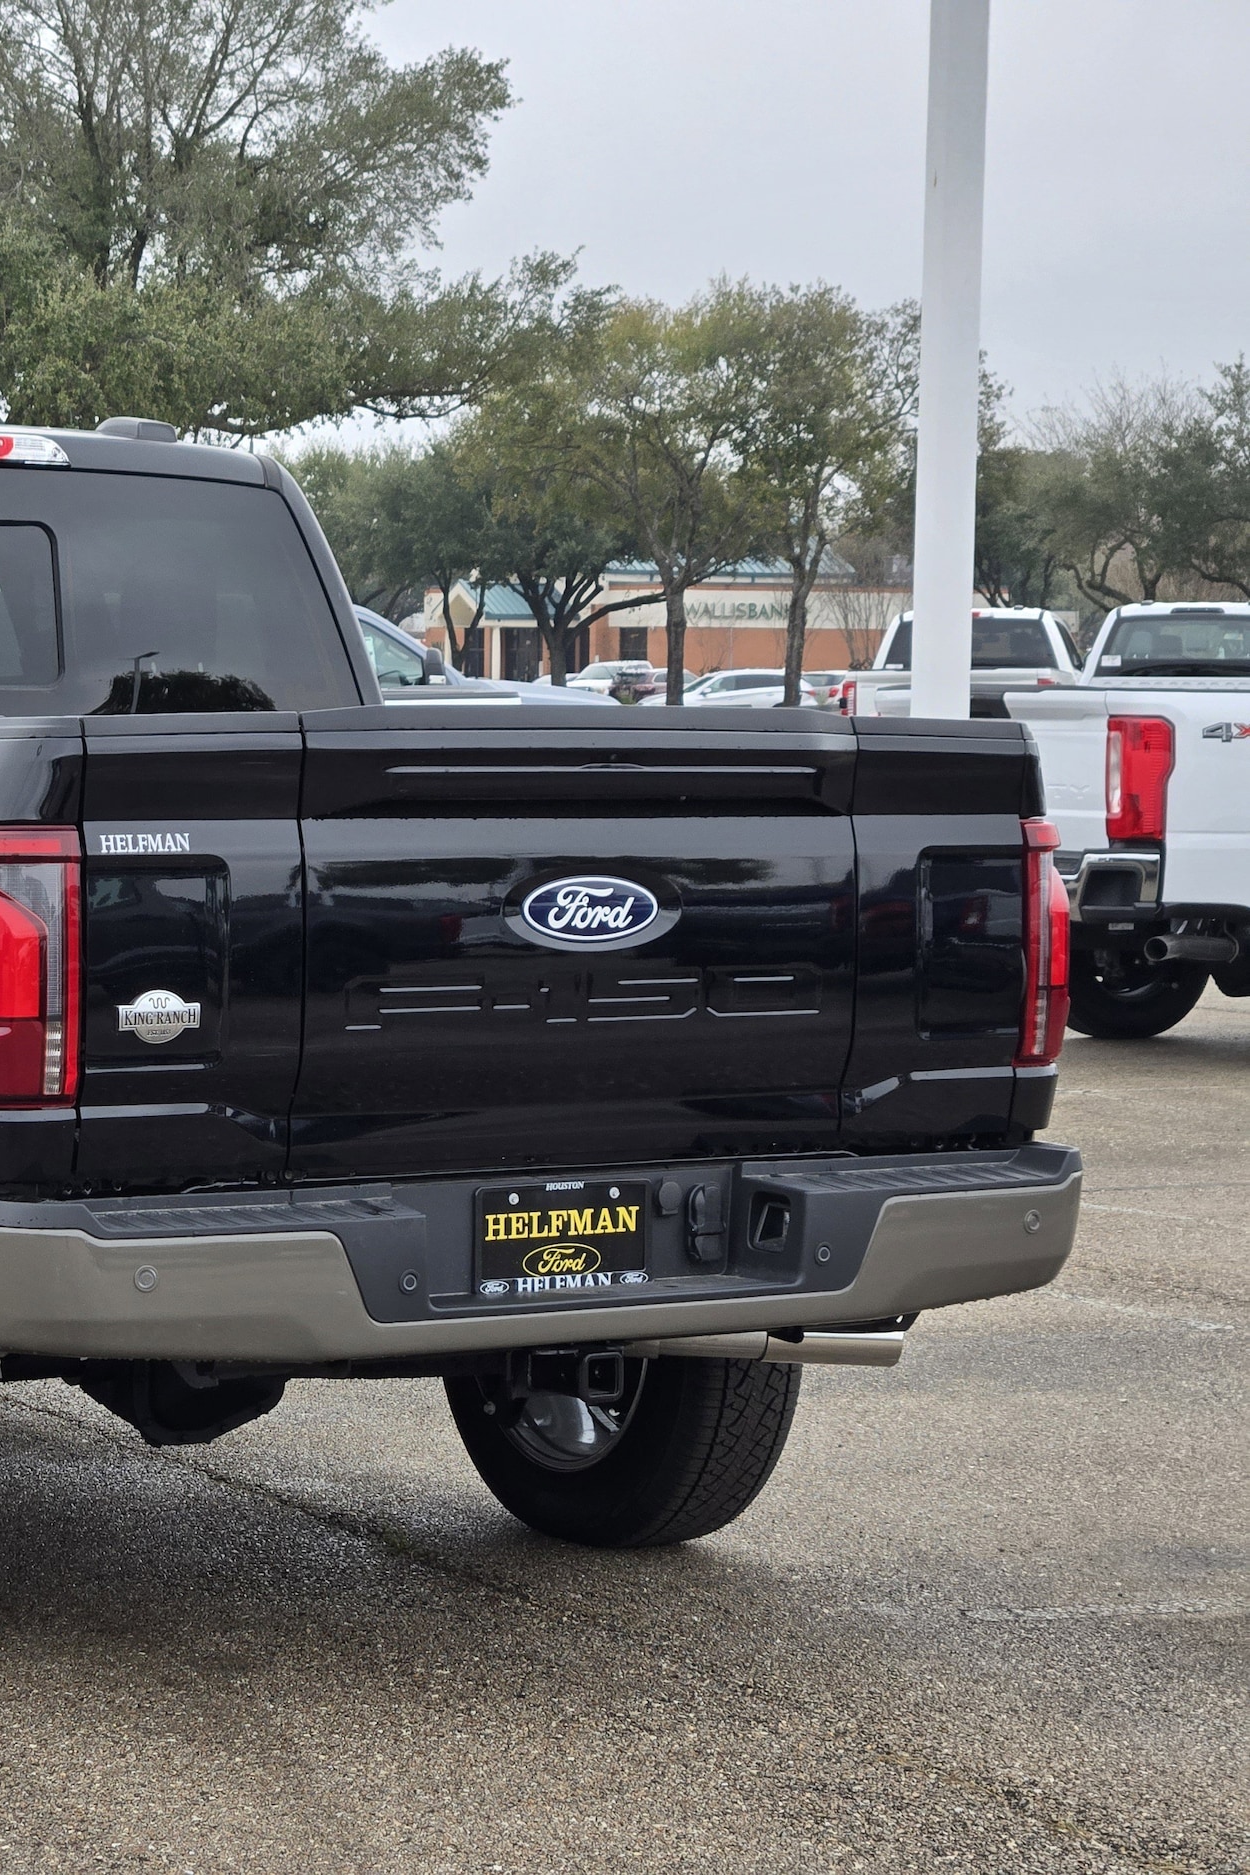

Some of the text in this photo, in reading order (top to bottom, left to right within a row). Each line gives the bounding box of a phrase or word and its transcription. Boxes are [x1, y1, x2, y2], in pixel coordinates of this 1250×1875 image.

[99, 833, 190, 854] HELFMAN
[547, 885, 635, 930] Ford
[124, 1008, 196, 1026] KING RANCH
[545, 1181, 585, 1192] HOUSTON
[485, 1205, 640, 1241] HELFMAN
[537, 1247, 587, 1274] Ford
